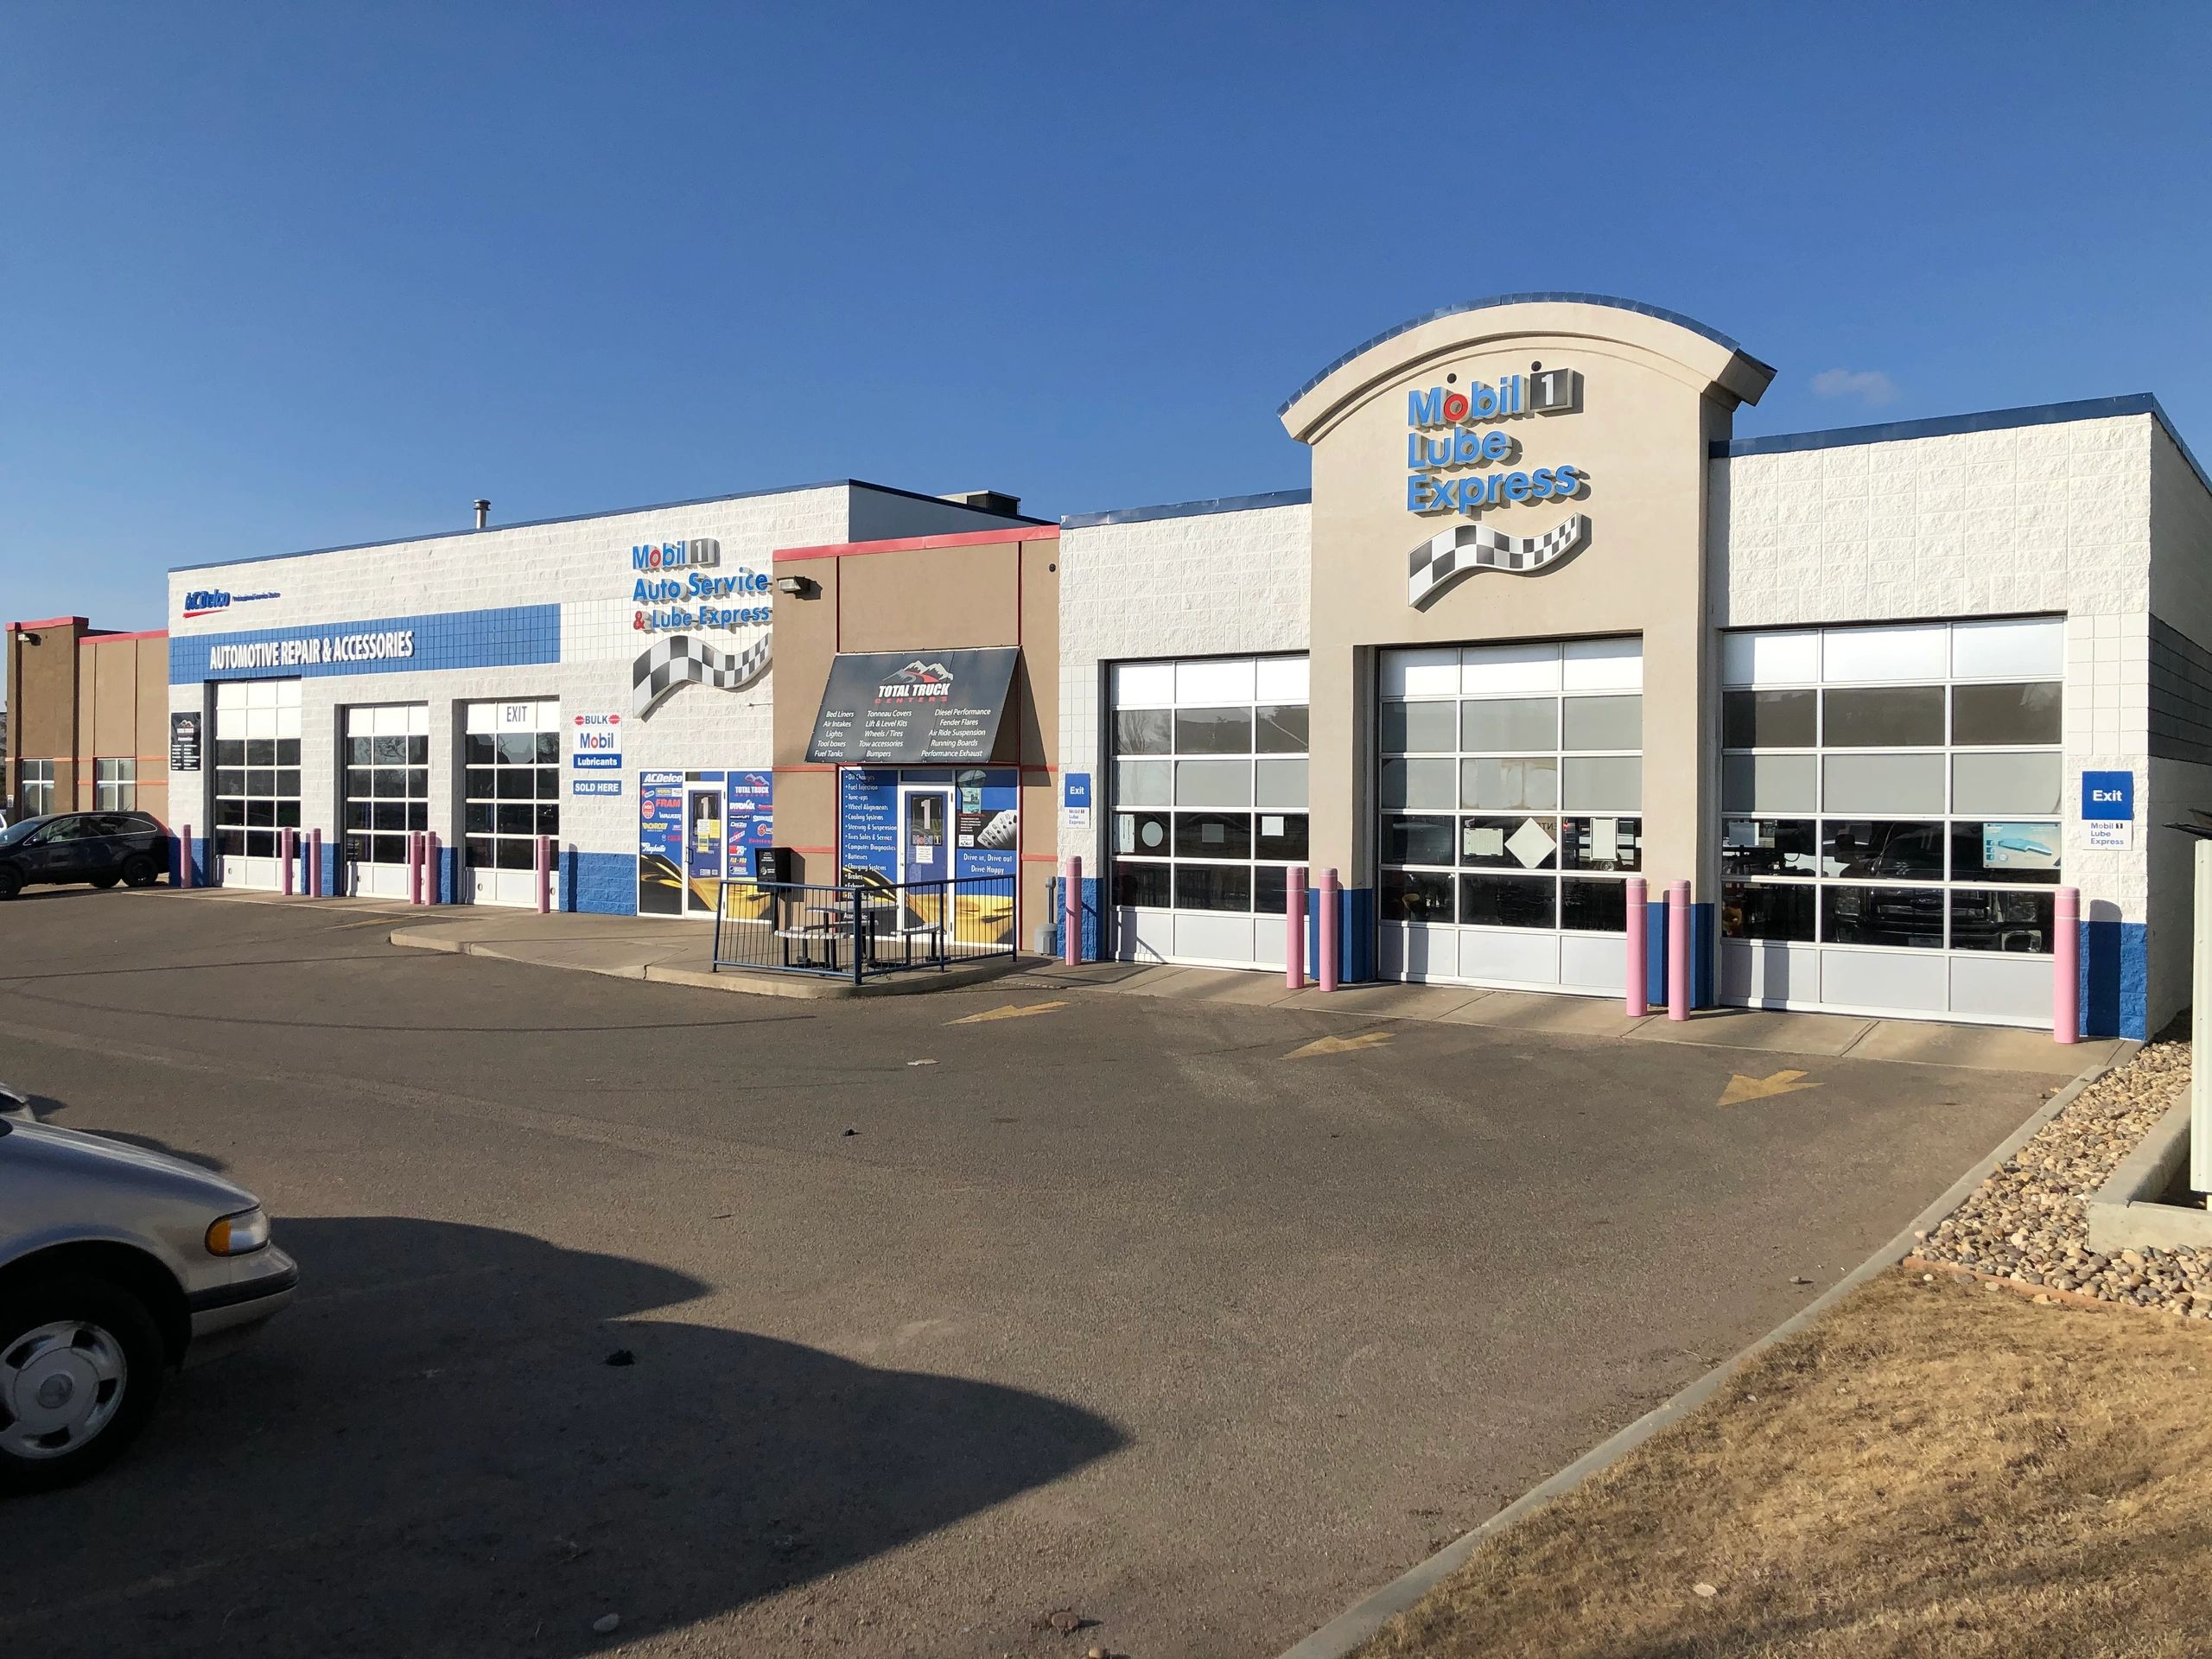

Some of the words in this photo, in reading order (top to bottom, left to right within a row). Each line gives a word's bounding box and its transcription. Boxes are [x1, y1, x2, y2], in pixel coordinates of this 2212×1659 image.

[1408, 374, 1520, 427] Mobil
[1541, 373, 1554, 405] 1
[1408, 427, 1508, 468] Lube
[1408, 465, 1579, 514] Express
[632, 541, 687, 569] Mobil
[696, 541, 702, 563] 1
[632, 578, 681, 601] Auto
[689, 567, 768, 597] Service
[633, 611, 645, 630] &
[652, 607, 692, 629] Lube
[699, 606, 770, 629] Express
[210, 641, 280, 670] AUTOMOTIVE
[281, 639, 321, 665] REPAIR
[322, 637, 332, 663] &
[333, 630, 414, 662] ACCESSORIES
[878, 684, 910, 698] TOTAL
[912, 683, 950, 696] TRUCK
[506, 705, 528, 722] EXIT
[585, 715, 607, 725] BULK
[825, 730, 843, 739] Lights
[951, 728, 986, 738] Suspension
[580, 732, 614, 749] Mobil
[871, 739, 904, 747] accessories
[931, 739, 957, 748] Running
[957, 738, 979, 747] Boards
[827, 749, 844, 758] Tanks
[866, 749, 892, 759] Bumpers
[577, 757, 618, 766] Lubricants
[644, 773, 683, 783] ACDelco
[575, 783, 595, 792] SOLD
[597, 783, 619, 792] HERE
[1070, 786, 1084, 795] Exit
[2093, 790, 2123, 802] Exit
[656, 799, 681, 808] FRAM
[863, 804, 888, 812] Alignments
[848, 813, 865, 822] Cooling
[866, 813, 884, 822] Systems
[921, 798, 931, 830] 1
[912, 834, 933, 845] Mobil
[848, 842, 869, 851] Computer
[870, 843, 896, 853] Diagnostics
[848, 863, 868, 872] Charging
[868, 863, 887, 872] Systems
[970, 864, 985, 873] Drive
[986, 865, 1004, 875] Happy
